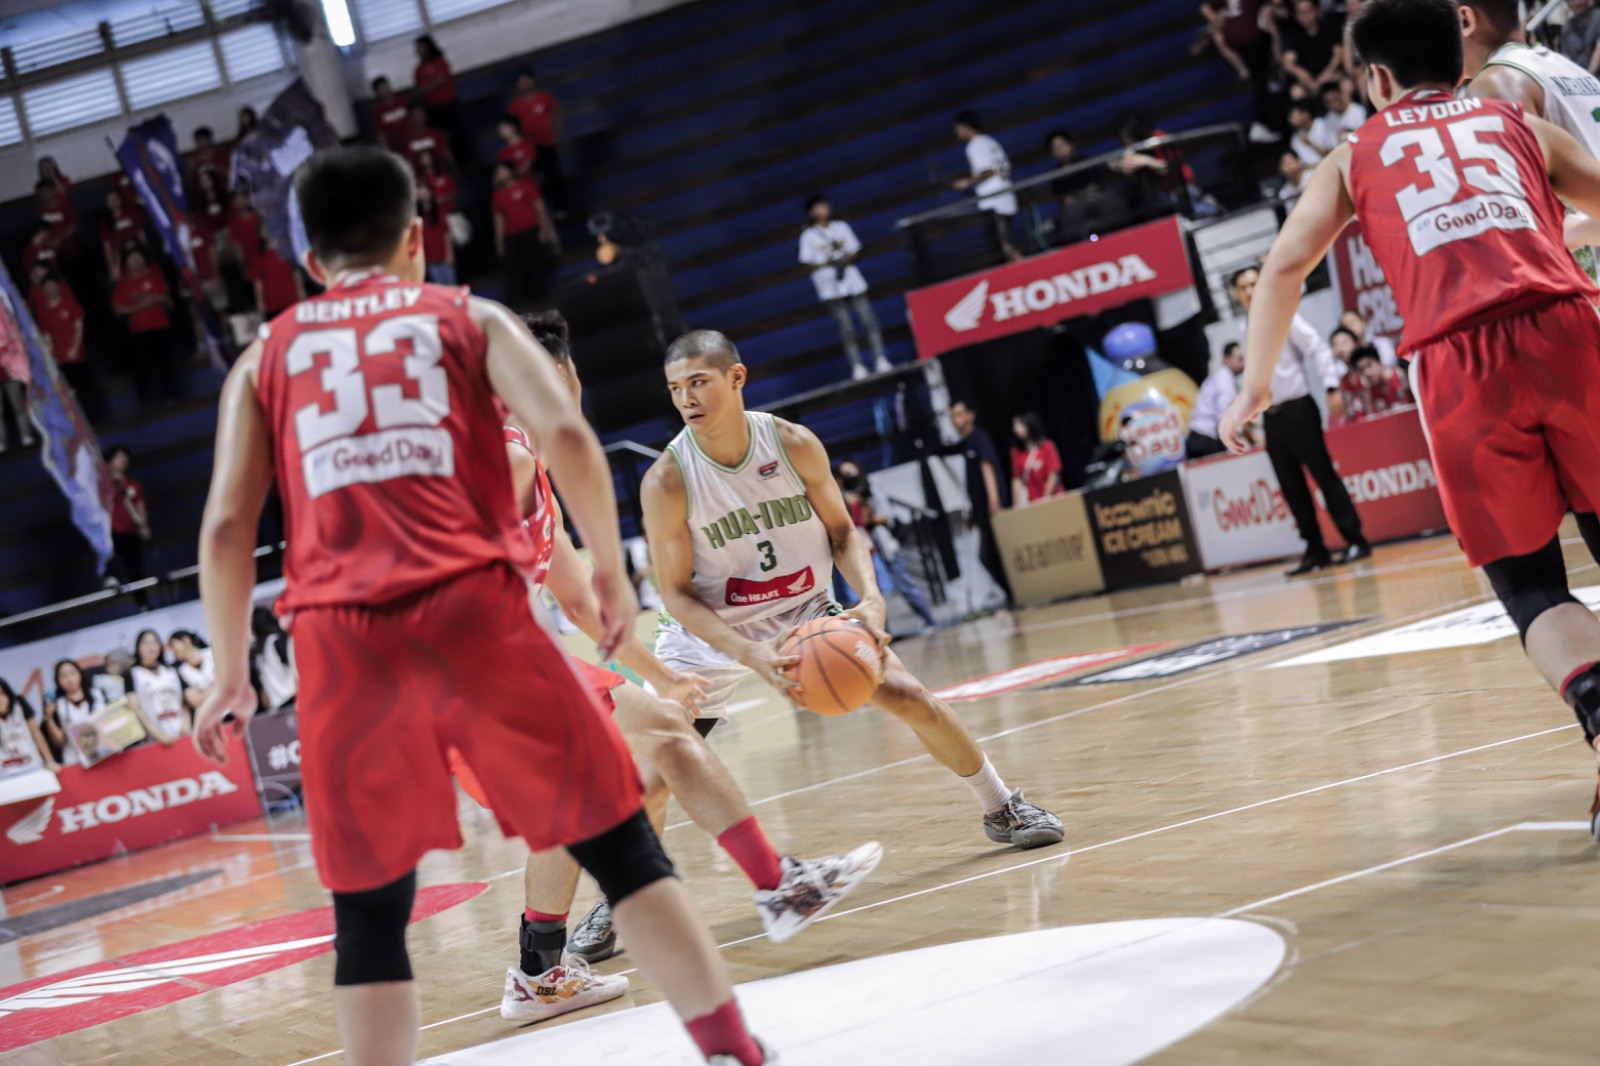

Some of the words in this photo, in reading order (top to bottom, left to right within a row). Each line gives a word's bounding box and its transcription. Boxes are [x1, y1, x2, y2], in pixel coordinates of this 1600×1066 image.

[1383, 97, 1483, 127] LEYDON
[1379, 115, 1526, 222] 35
[296, 287, 422, 323] BENTLEY
[989, 254, 1156, 321] HONDA
[285, 314, 450, 452] 33
[1342, 459, 1437, 503] HONDA
[699, 495, 812, 549] HUA-IND
[757, 540, 777, 572] 3
[748, 589, 780, 602] HEART
[57, 770, 238, 834] HONDA
[536, 986, 557, 996] DBL
